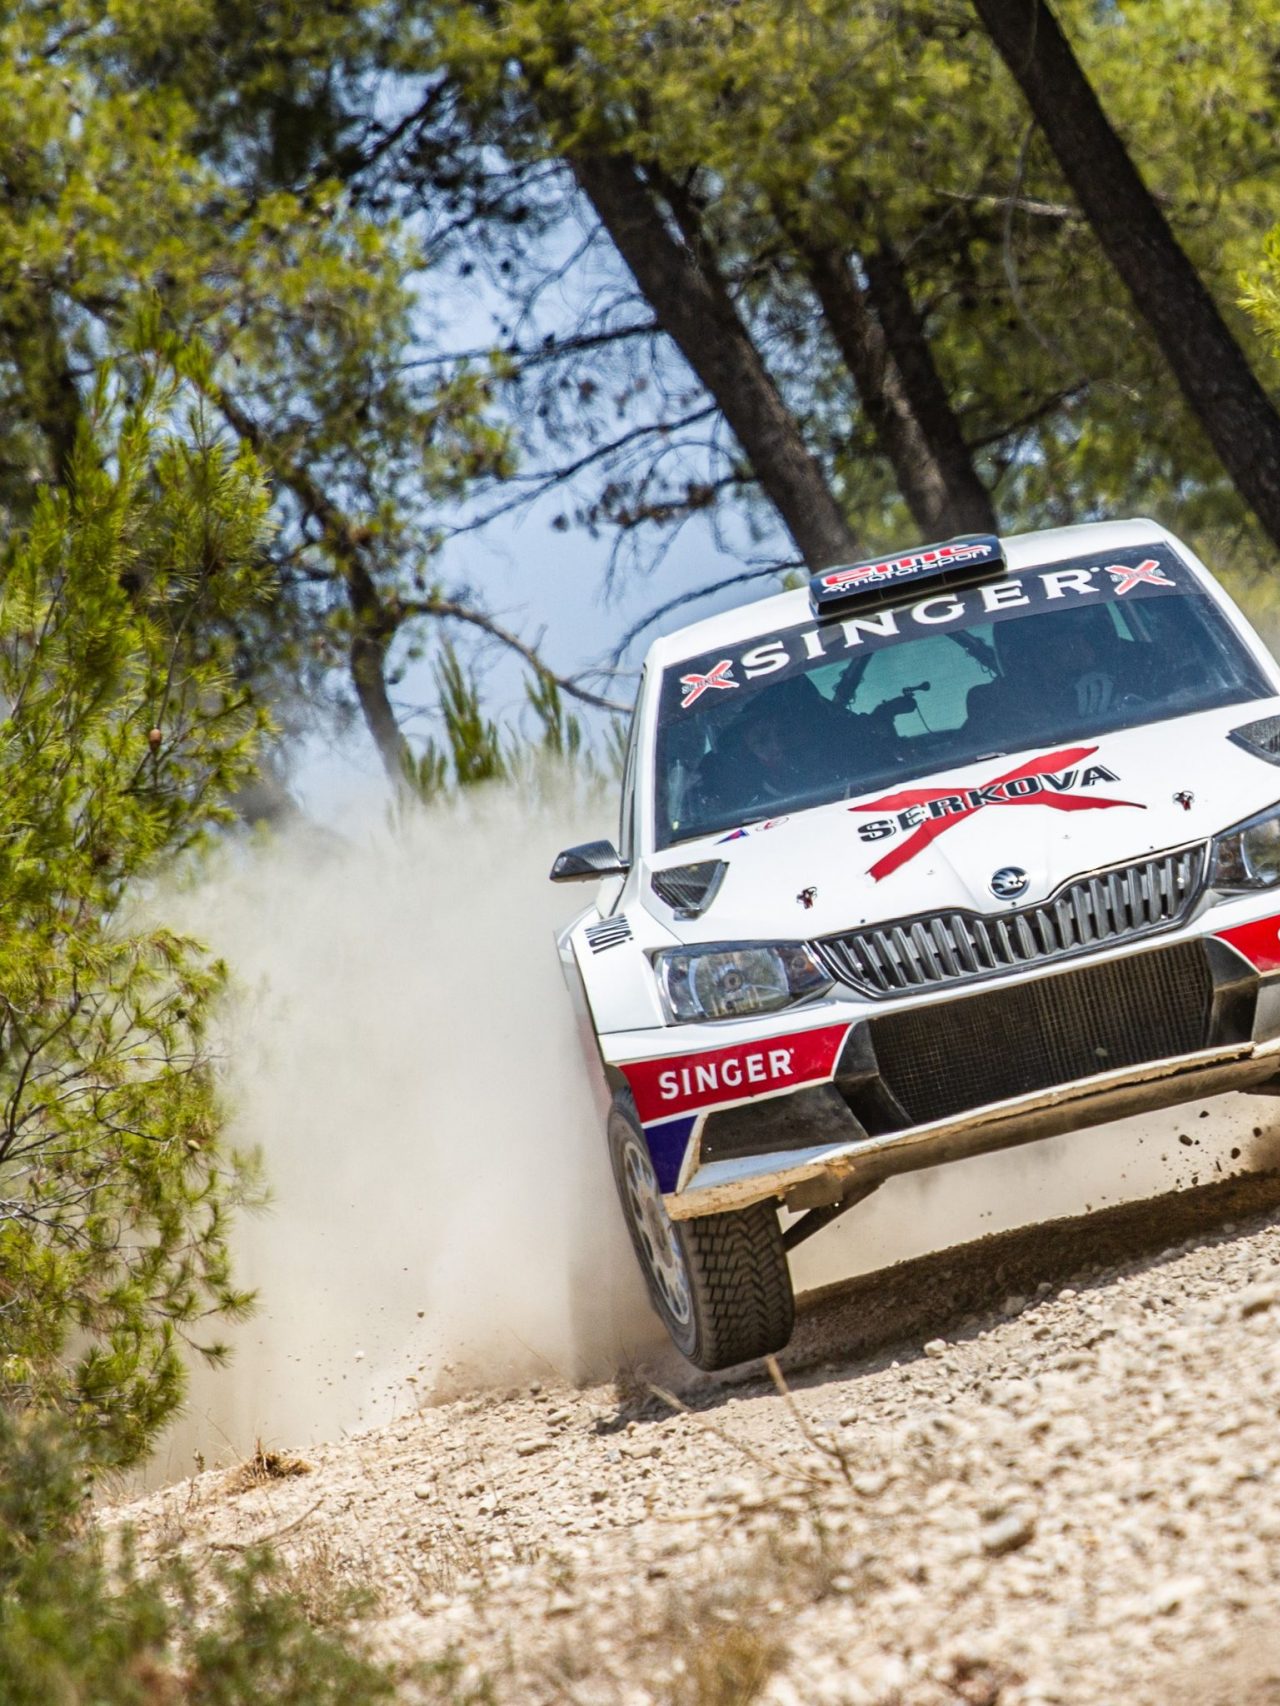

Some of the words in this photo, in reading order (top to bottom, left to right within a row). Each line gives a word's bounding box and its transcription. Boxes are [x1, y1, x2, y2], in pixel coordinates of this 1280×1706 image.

[741, 567, 1099, 679] SINGER
[857, 765, 1121, 842] SERKOVA
[658, 1050, 793, 1100] SINGER
